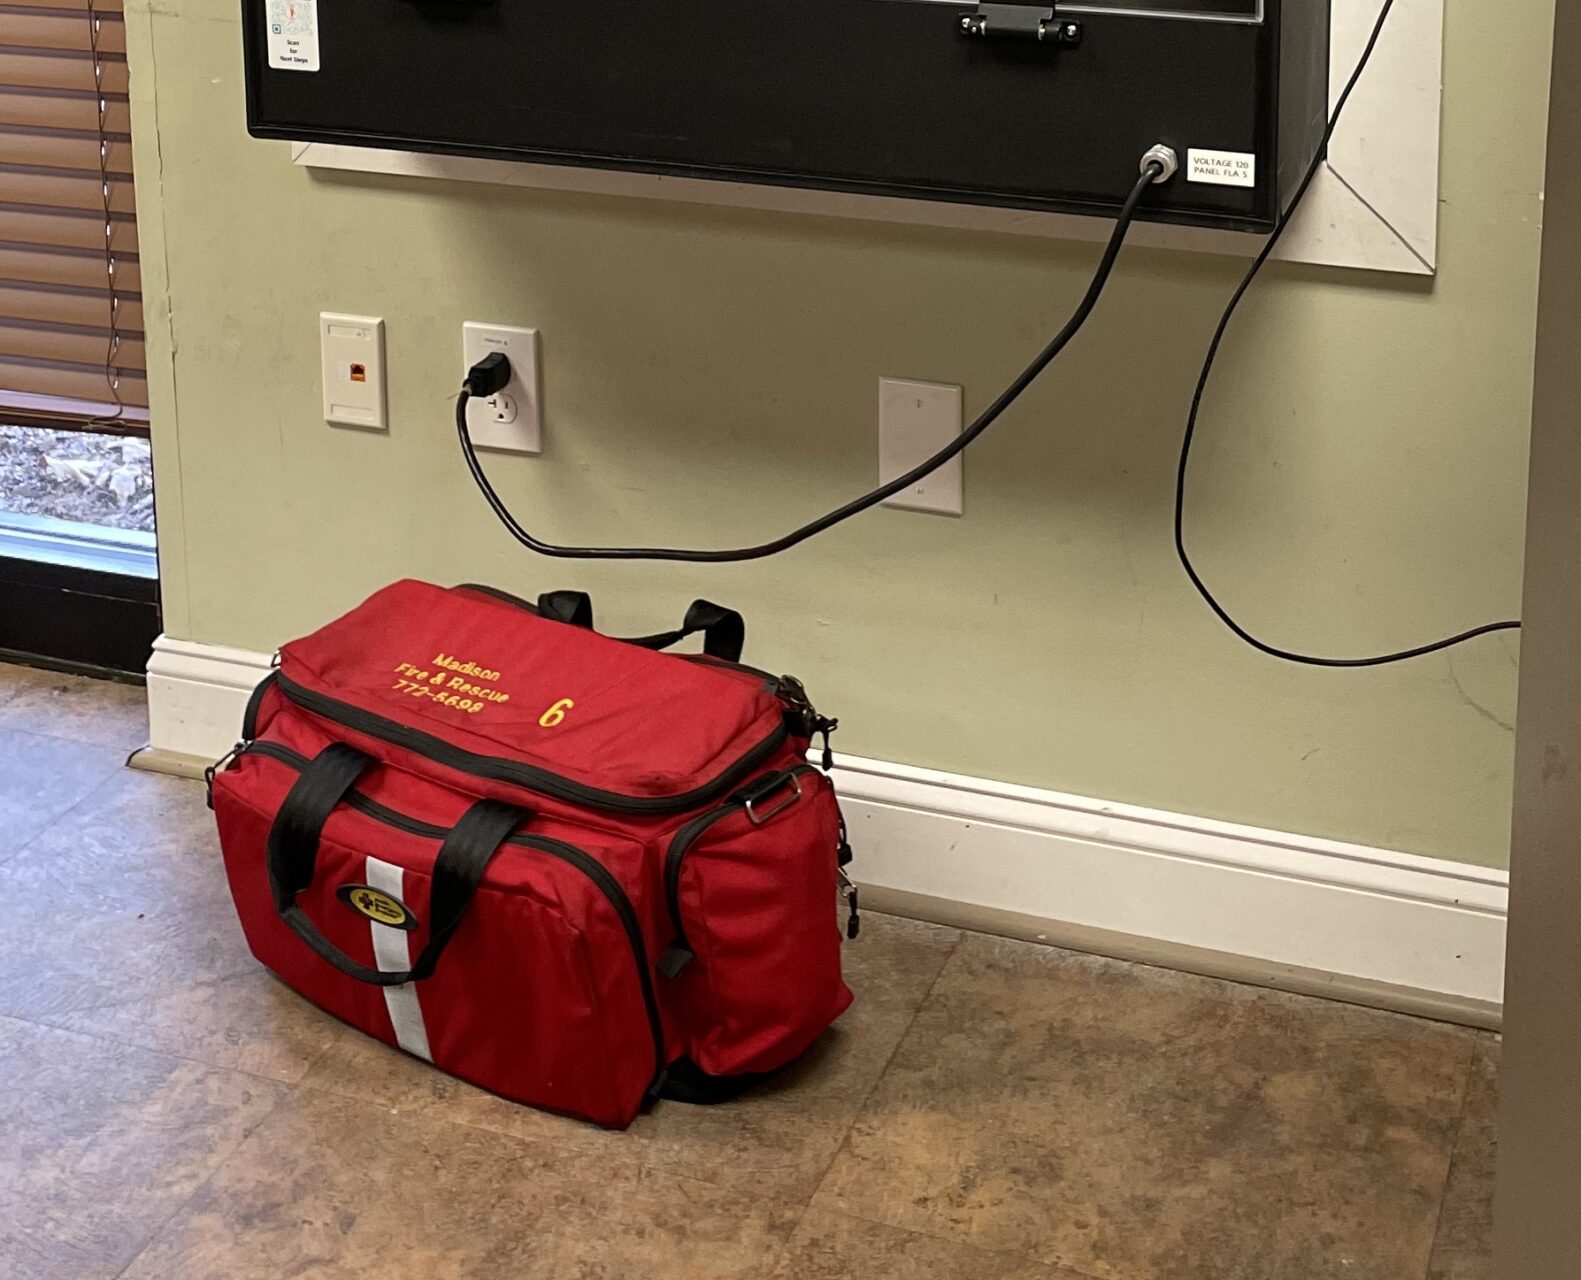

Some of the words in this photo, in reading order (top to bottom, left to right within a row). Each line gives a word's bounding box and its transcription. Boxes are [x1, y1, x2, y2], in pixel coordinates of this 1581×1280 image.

[1193, 157, 1232, 167] VOLTAGE
[1235, 161, 1249, 169] 120
[1194, 167, 1220, 176] PANEL
[1224, 169, 1239, 177] FLA
[432, 653, 501, 681] Madison
[393, 679, 484, 713] 772-5698
[394, 663, 429, 680] Fire
[429, 672, 446, 685] &
[446, 677, 510, 703] Rescue
[539, 698, 574, 728] 6
